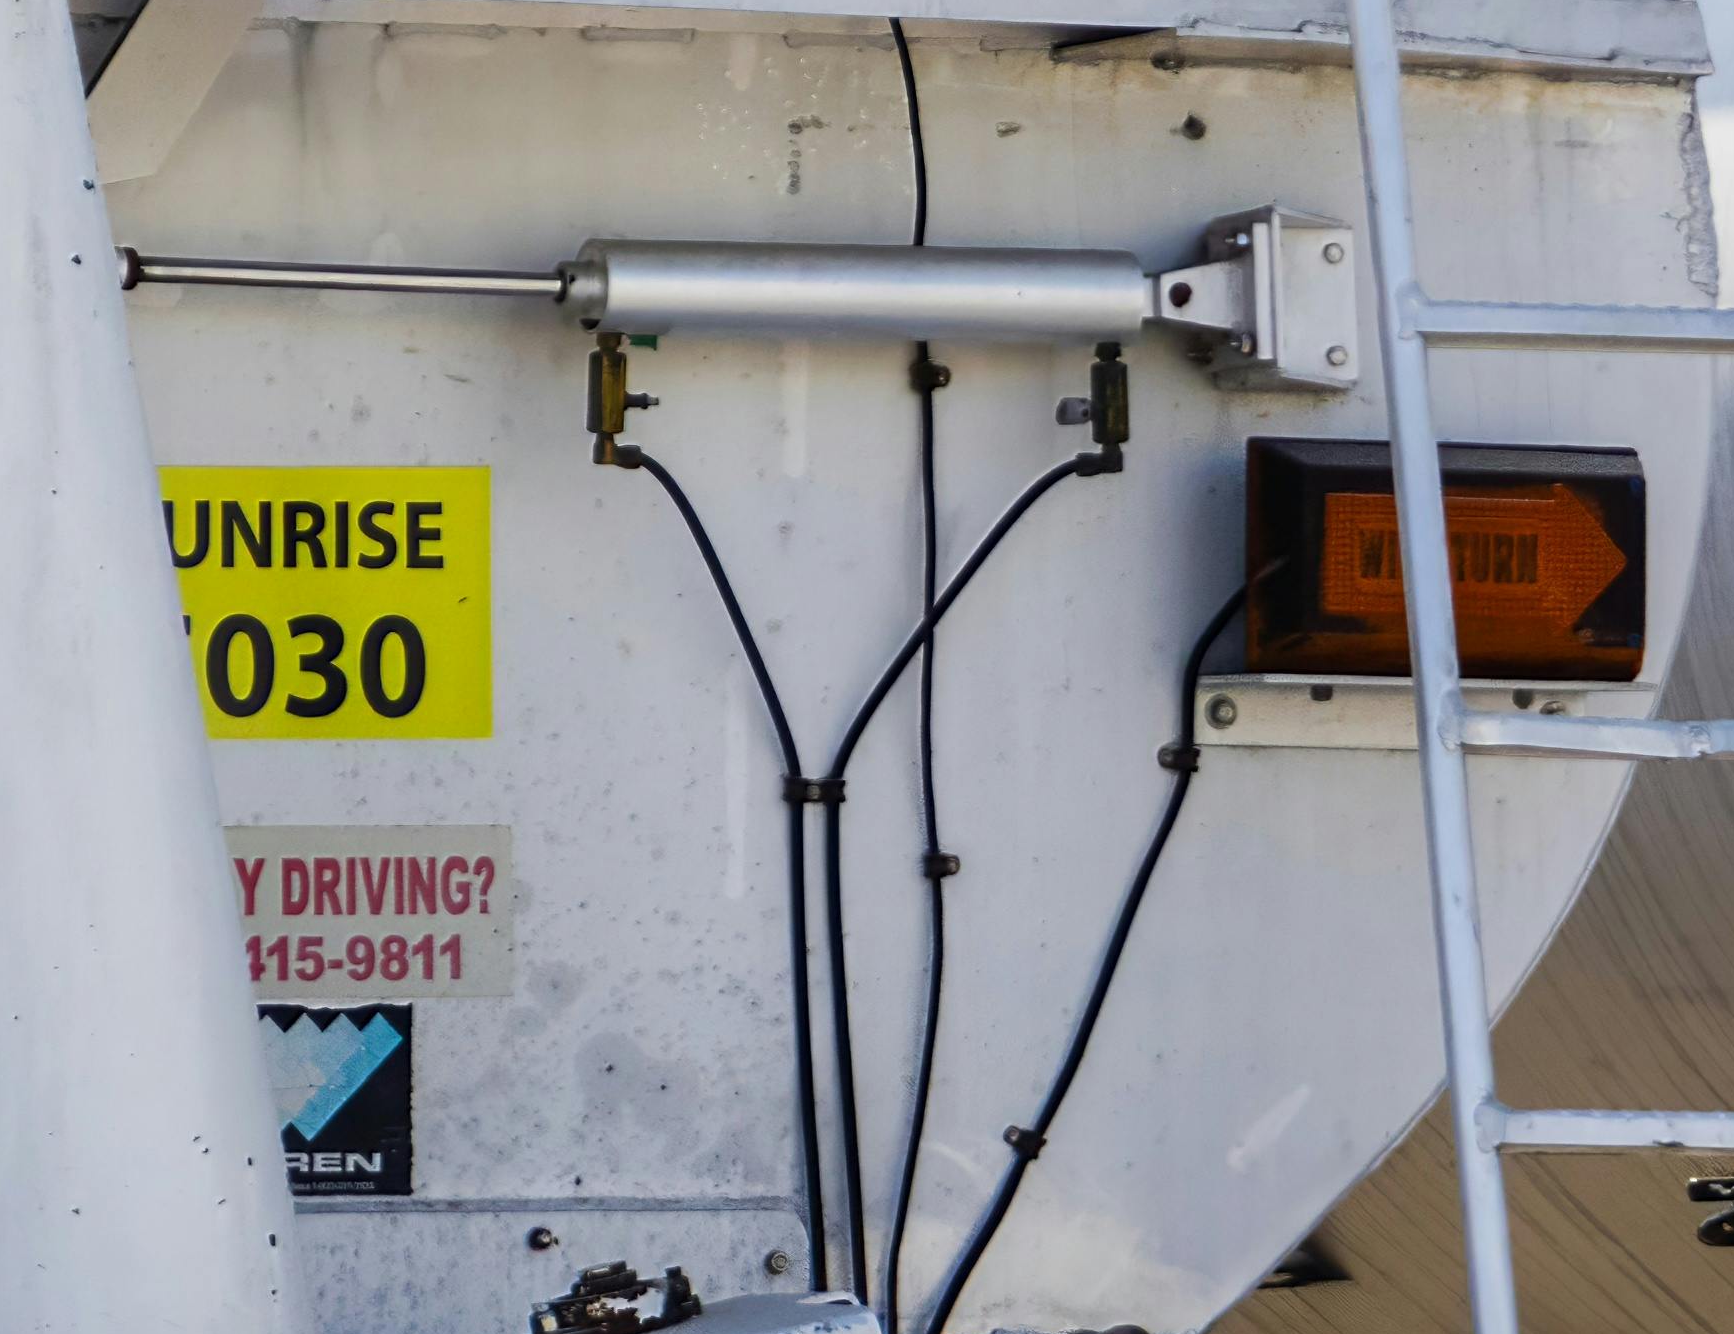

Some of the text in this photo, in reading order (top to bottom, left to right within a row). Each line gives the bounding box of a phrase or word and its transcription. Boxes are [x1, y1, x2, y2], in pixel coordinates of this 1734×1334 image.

[162, 500, 444, 569] UNRISE
[183, 613, 425, 718] 030
[233, 856, 496, 916] Y DRIVING?
